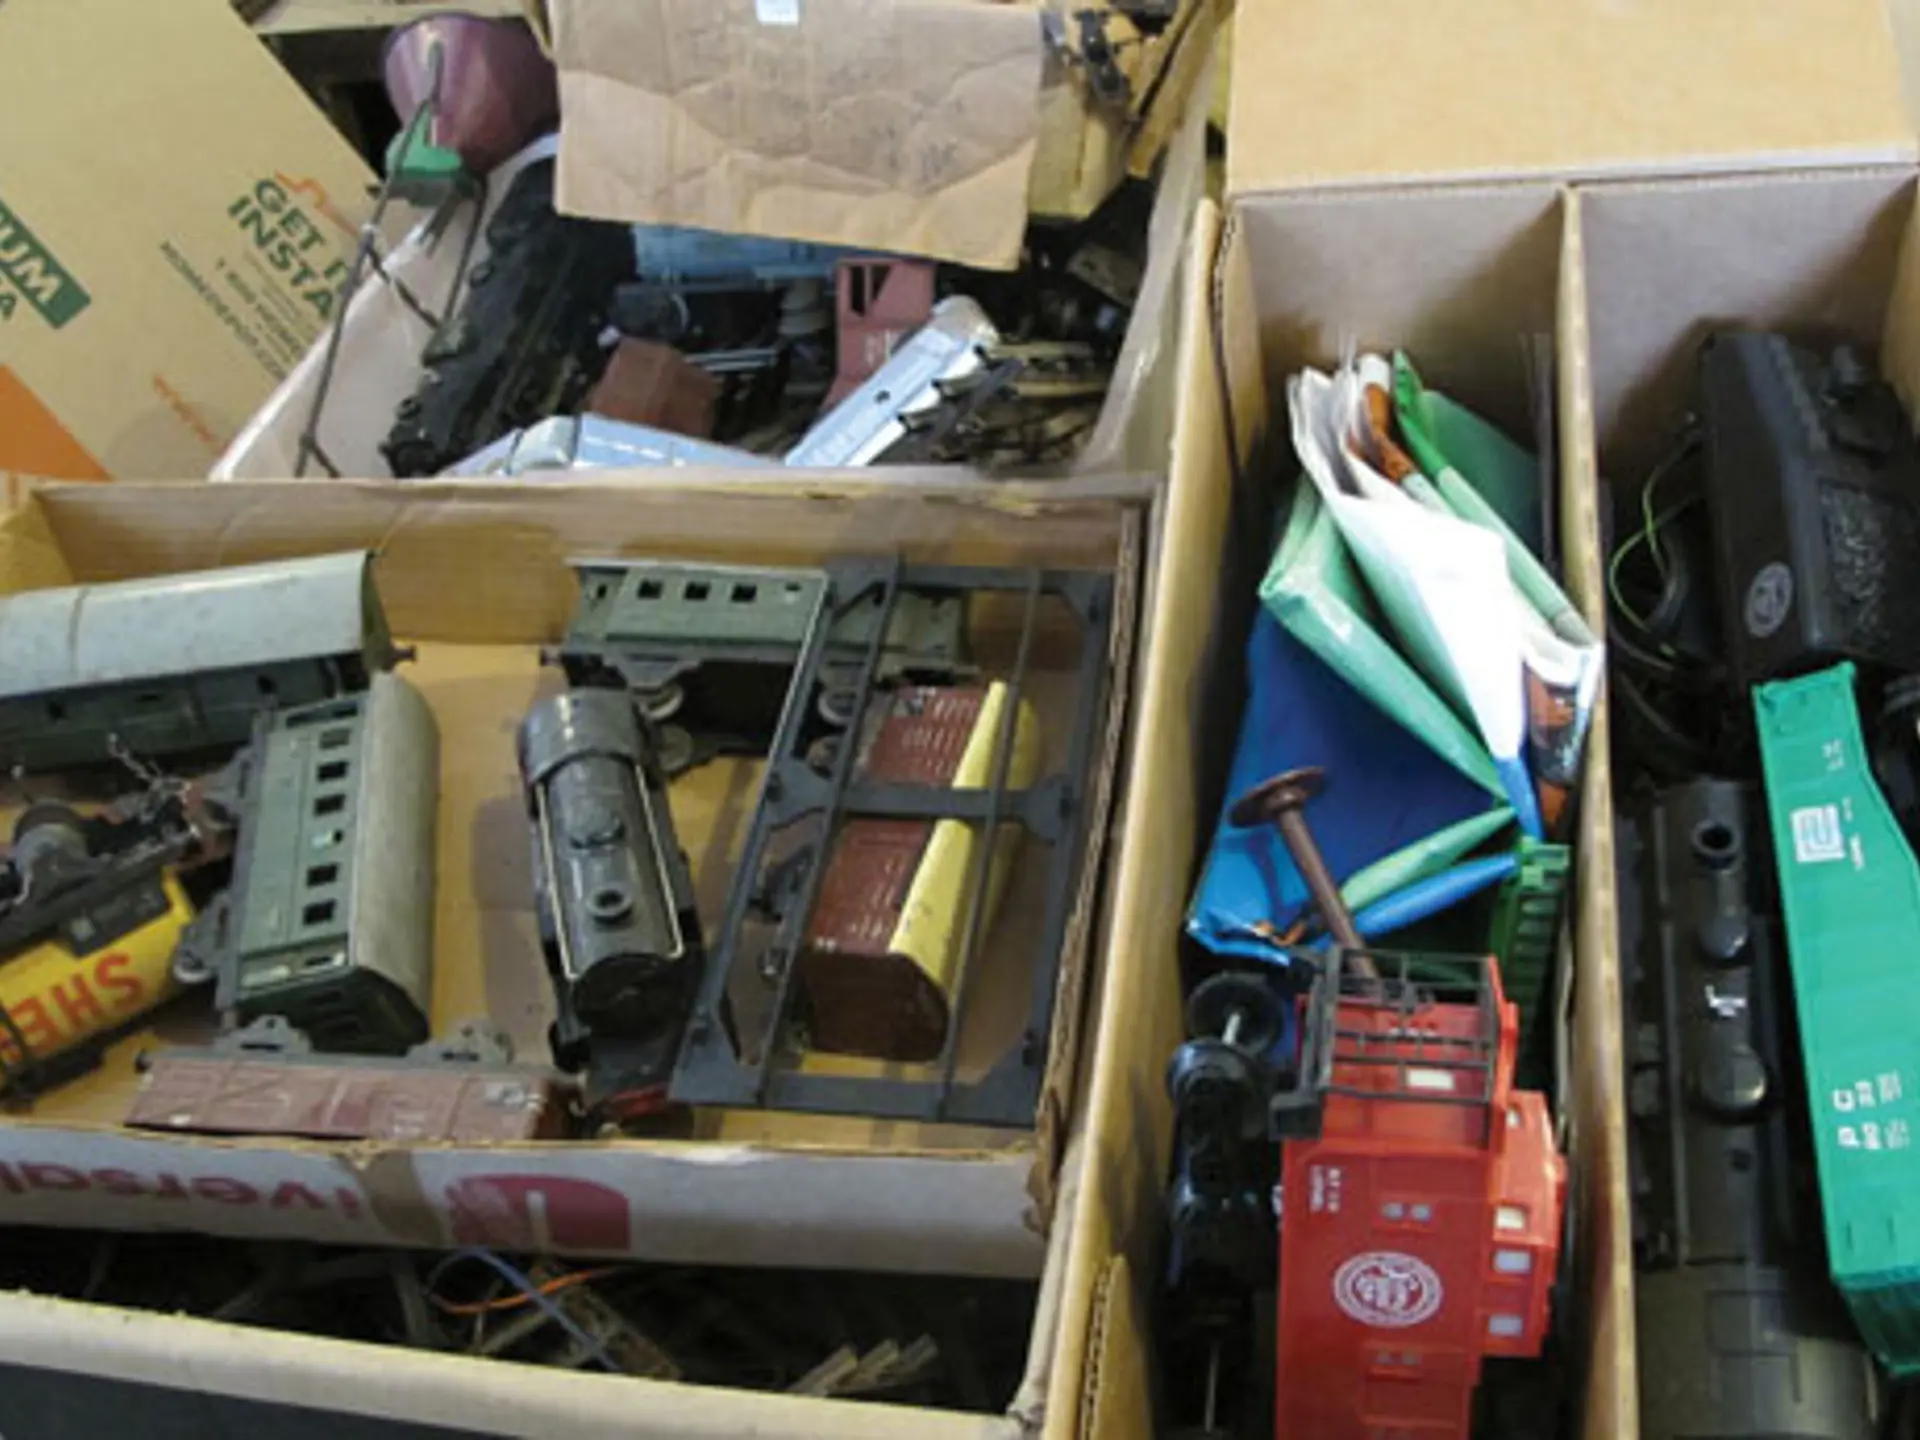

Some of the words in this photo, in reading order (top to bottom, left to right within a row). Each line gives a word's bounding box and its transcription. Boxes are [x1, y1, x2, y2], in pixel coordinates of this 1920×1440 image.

[0, 213, 61, 305] UM
[227, 195, 333, 319] INSTA
[255, 179, 326, 250] GET
[0, 953, 144, 1060] SHE
